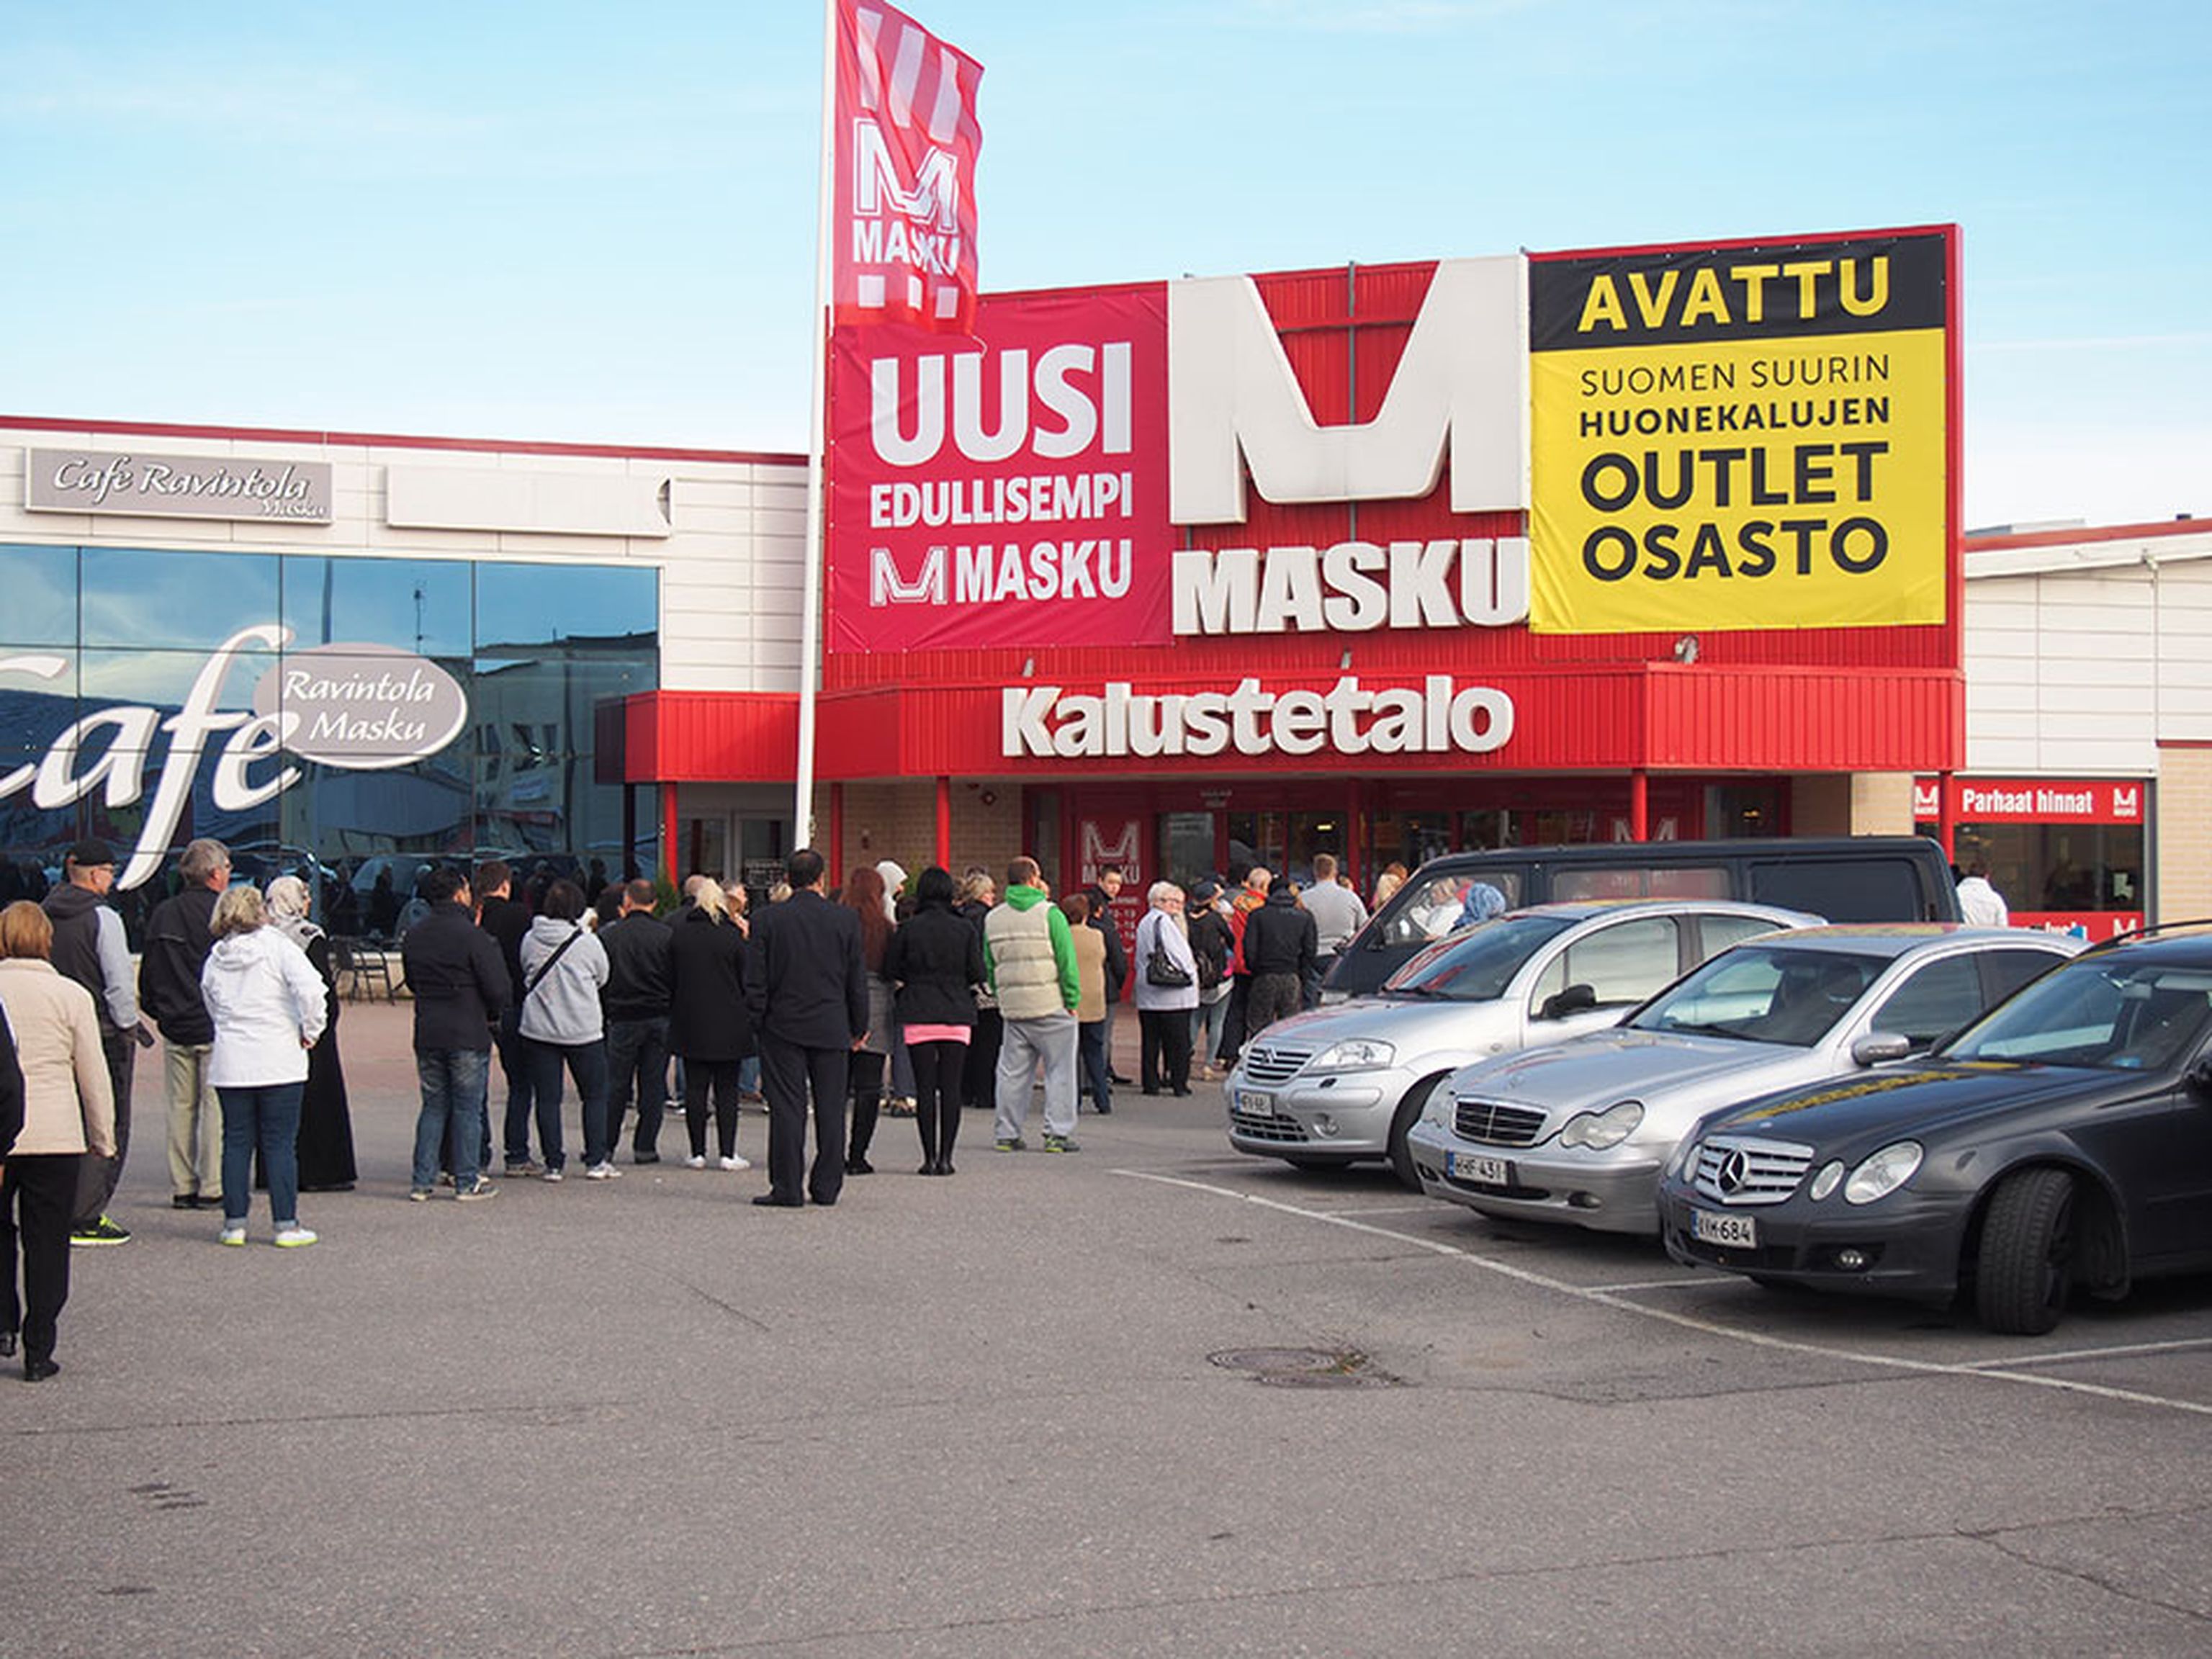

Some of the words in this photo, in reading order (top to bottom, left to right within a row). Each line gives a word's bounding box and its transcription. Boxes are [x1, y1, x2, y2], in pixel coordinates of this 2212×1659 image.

[1577, 256, 1889, 333] AVATTU
[871, 341, 1132, 467] UUSI
[1581, 363, 1735, 397] SUOMEN
[1751, 354, 1889, 388] SUURIN
[1580, 397, 1889, 438] HUONEKALUJEN
[54, 456, 134, 505] Cafe
[139, 462, 311, 500] Ravintola
[870, 472, 1133, 529] EDULLISEMPI
[1581, 441, 1889, 513] OUTLET
[956, 539, 1133, 603] MASKU
[1581, 516, 1889, 583] OSASTO
[1172, 536, 1531, 635] MASKU
[282, 667, 436, 702] Ravintola
[309, 706, 427, 742] Masku
[1002, 675, 1514, 758] Kalustetalo
[1962, 788, 2033, 814] Parhaat
[2036, 789, 2094, 814] hinnat
[1082, 865, 1140, 885] MKU
